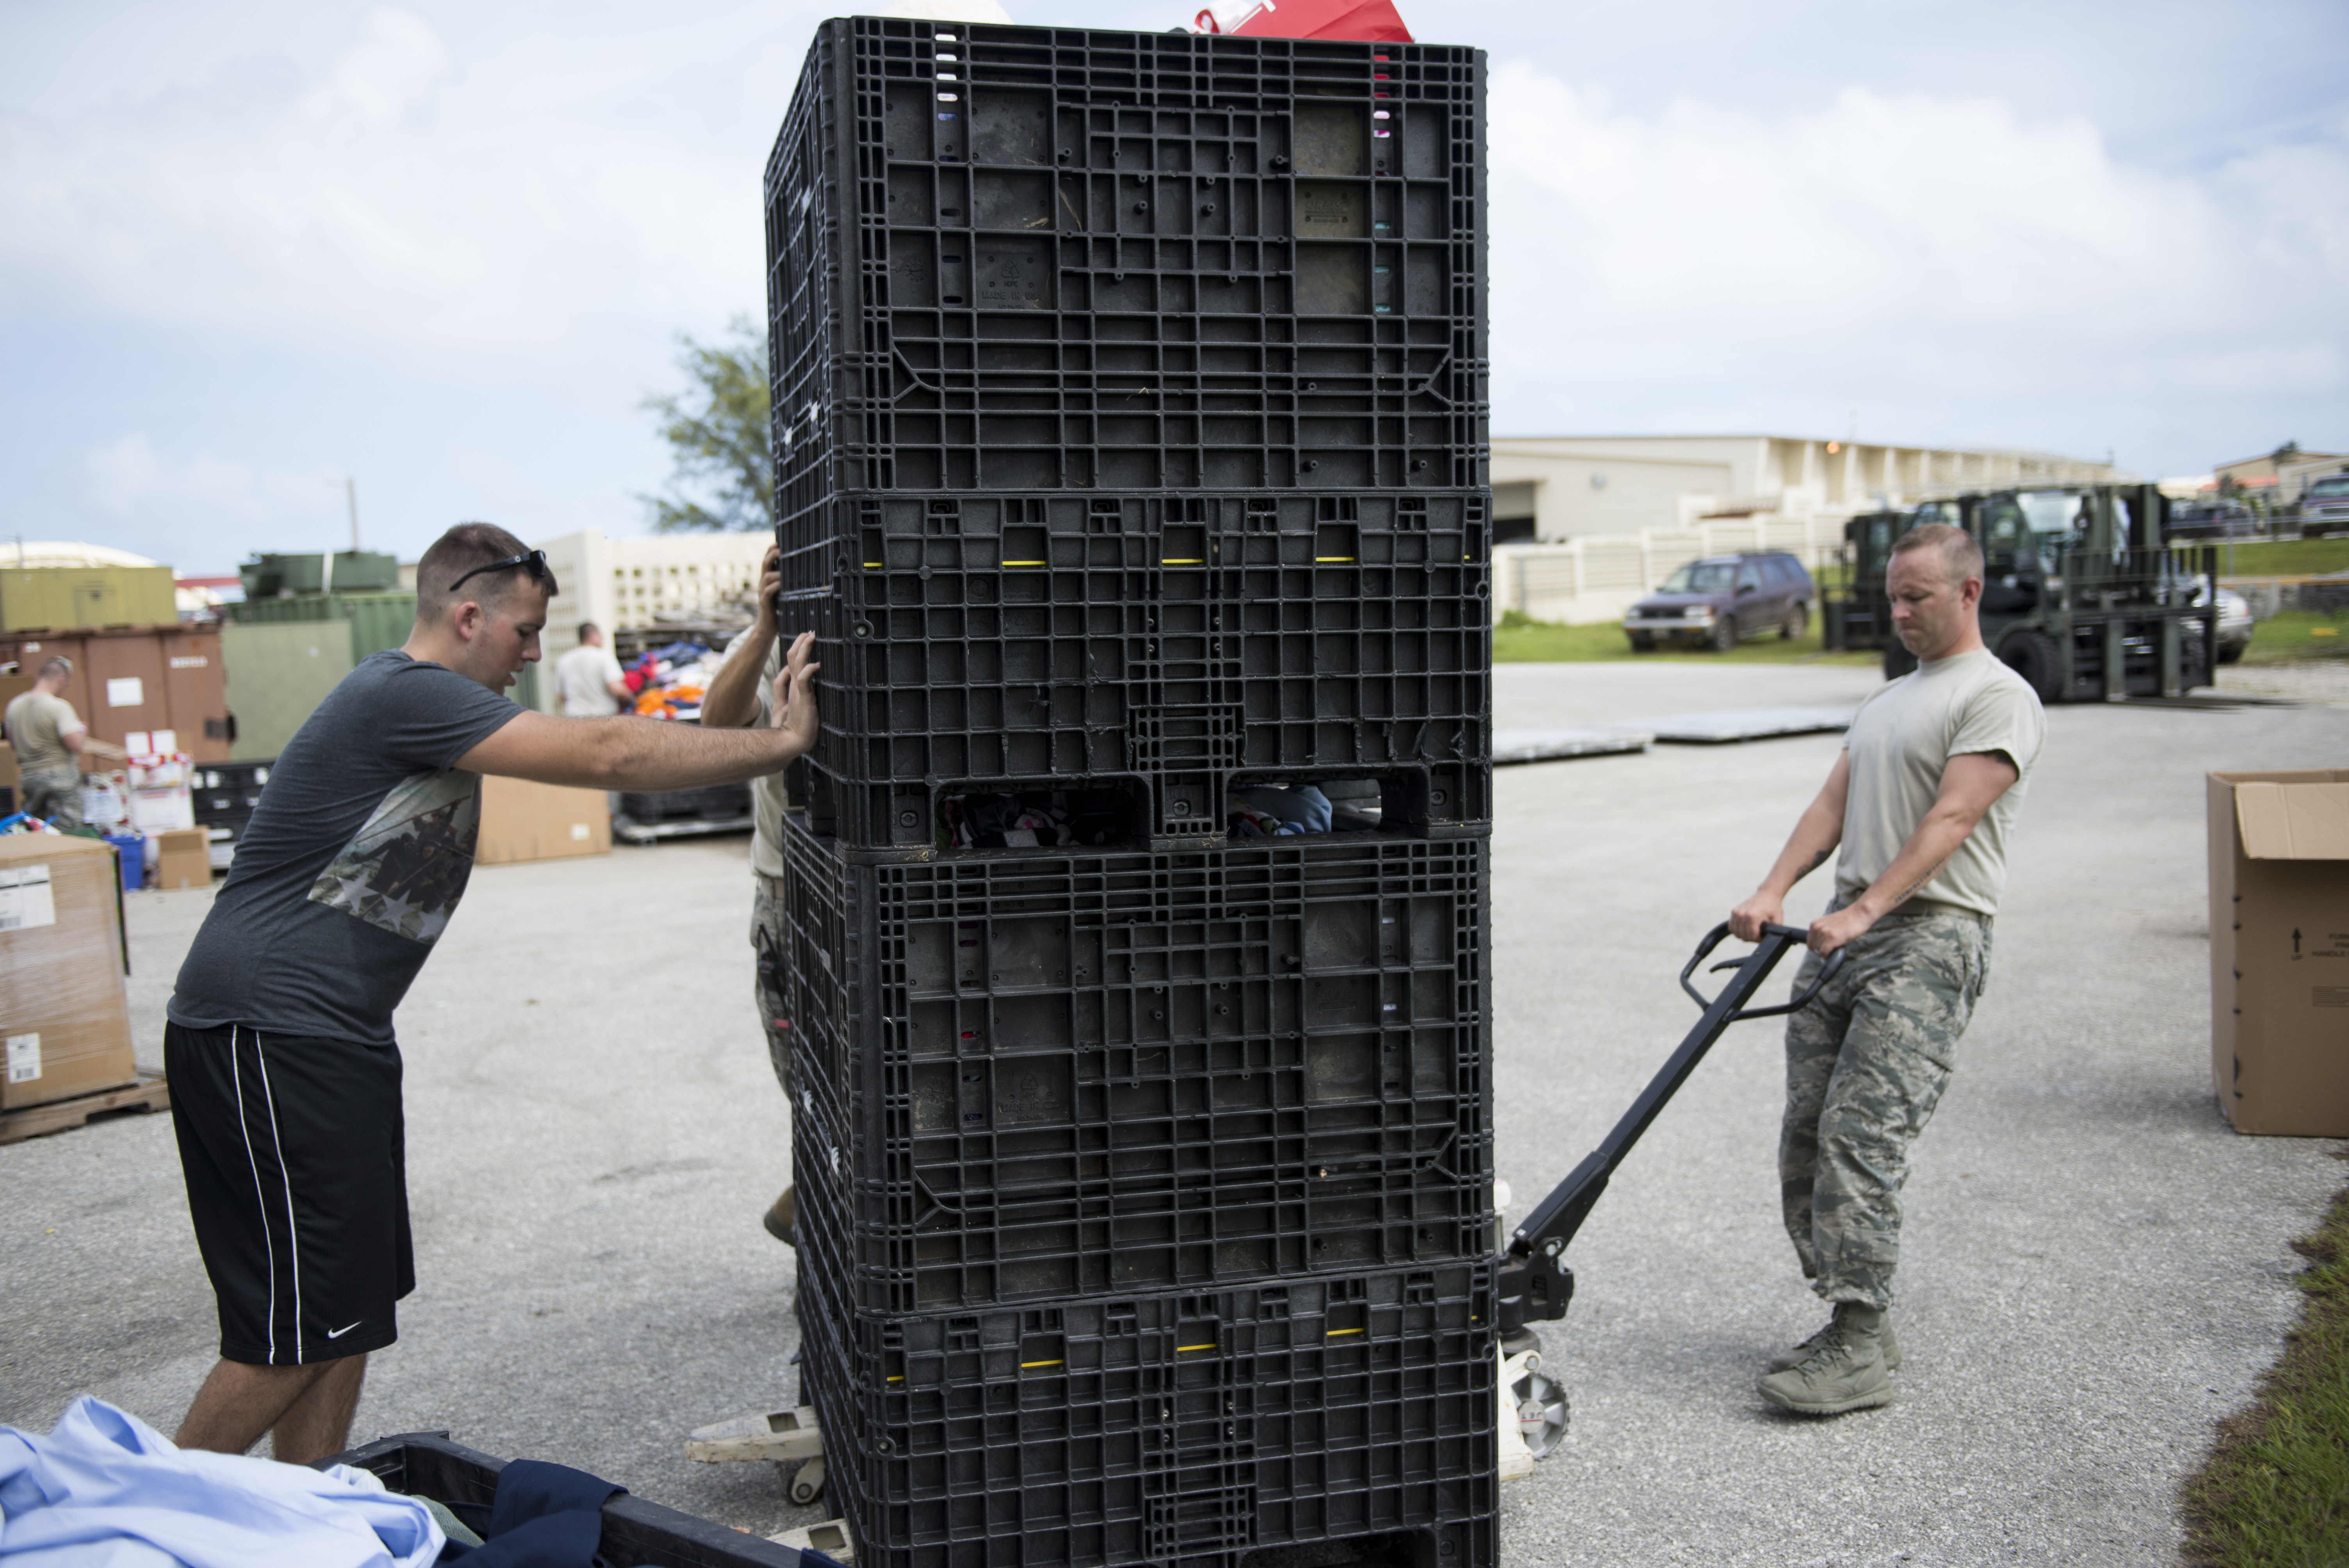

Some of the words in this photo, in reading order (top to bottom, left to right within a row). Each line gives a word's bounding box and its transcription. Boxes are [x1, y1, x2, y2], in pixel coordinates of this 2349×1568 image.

[982, 291, 1006, 299] MADE
[1011, 292, 1020, 300] IN
[1169, 787, 1194, 799] 1000
[900, 799, 916, 810] 40
[1002, 1103, 1025, 1113] MADE
[1030, 1101, 1039, 1110] IN
